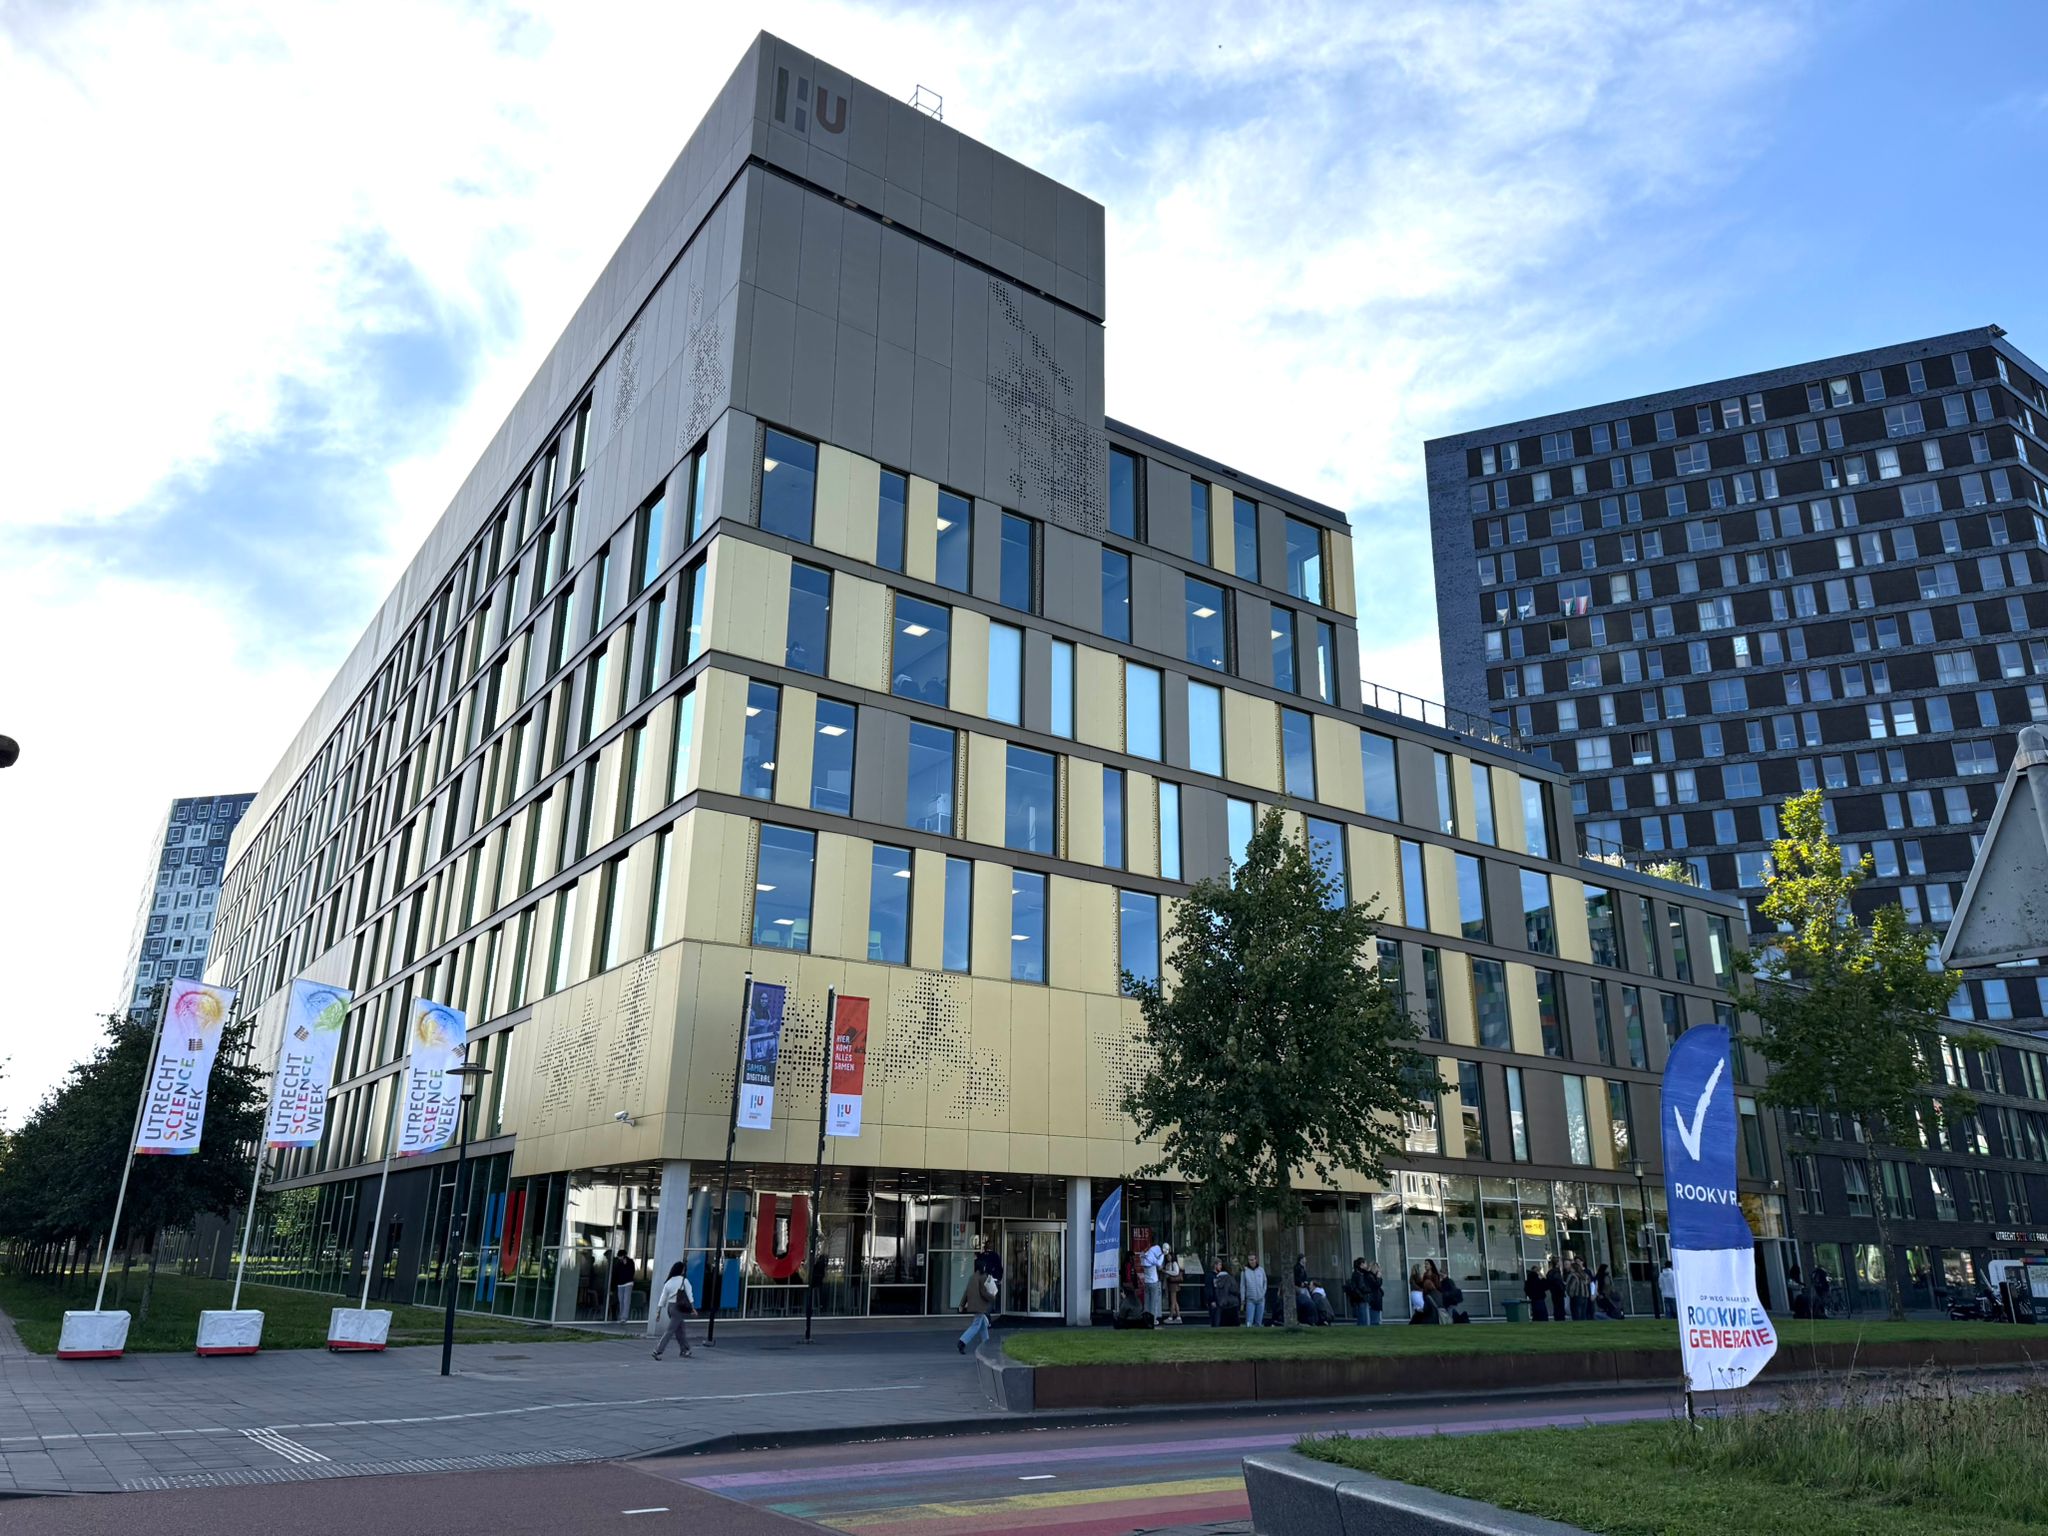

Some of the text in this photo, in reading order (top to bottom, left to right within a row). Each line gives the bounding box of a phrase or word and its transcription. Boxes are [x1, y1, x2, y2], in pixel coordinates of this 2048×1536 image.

[834, 1053, 853, 1062] ALLES
[835, 1044, 852, 1053] KOMT
[836, 1035, 850, 1044] HIER
[834, 1062, 855, 1071] SAMEN
[145, 1054, 178, 1140] UTRECHT
[163, 1057, 196, 1142] SCIENCE
[179, 1087, 204, 1141] WEEK
[274, 1053, 302, 1135] UTRECHT
[289, 1055, 314, 1135] SCIENCE
[305, 1083, 324, 1134] WEEK
[403, 1068, 428, 1145] UTRECHT
[420, 1069, 443, 1144] SCIENCE
[434, 1096, 457, 1142] WEEK
[1995, 1231, 2016, 1241] UTRECHT
[1689, 1327, 1774, 1349] GENERATIE
